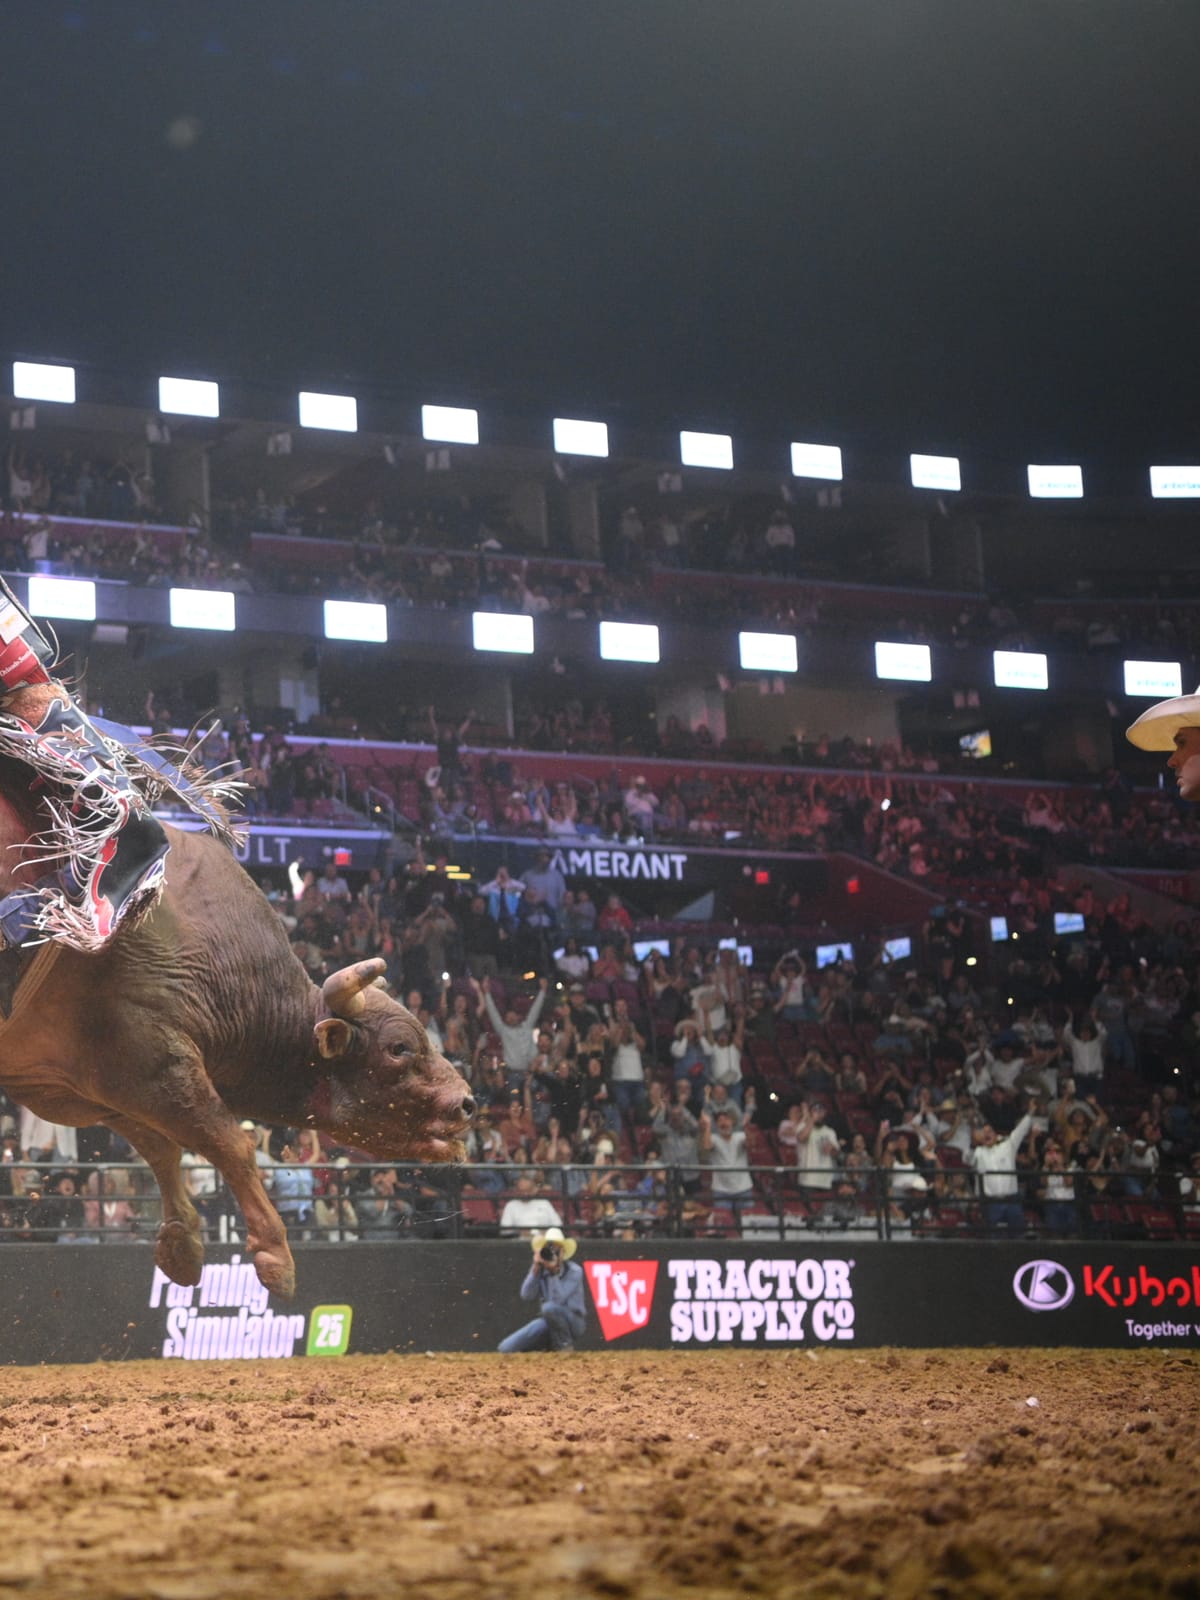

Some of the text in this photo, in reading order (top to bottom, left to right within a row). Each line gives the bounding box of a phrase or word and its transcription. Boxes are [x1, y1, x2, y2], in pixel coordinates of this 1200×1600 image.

[550, 850, 687, 880] AMERANT
[592, 1263, 647, 1324] TSC
[668, 1259, 852, 1300] TRACTOR
[162, 1307, 344, 1360] Simulator 25
[670, 1300, 807, 1342] SUPPLY
[1125, 1319, 1191, 1340] Together
